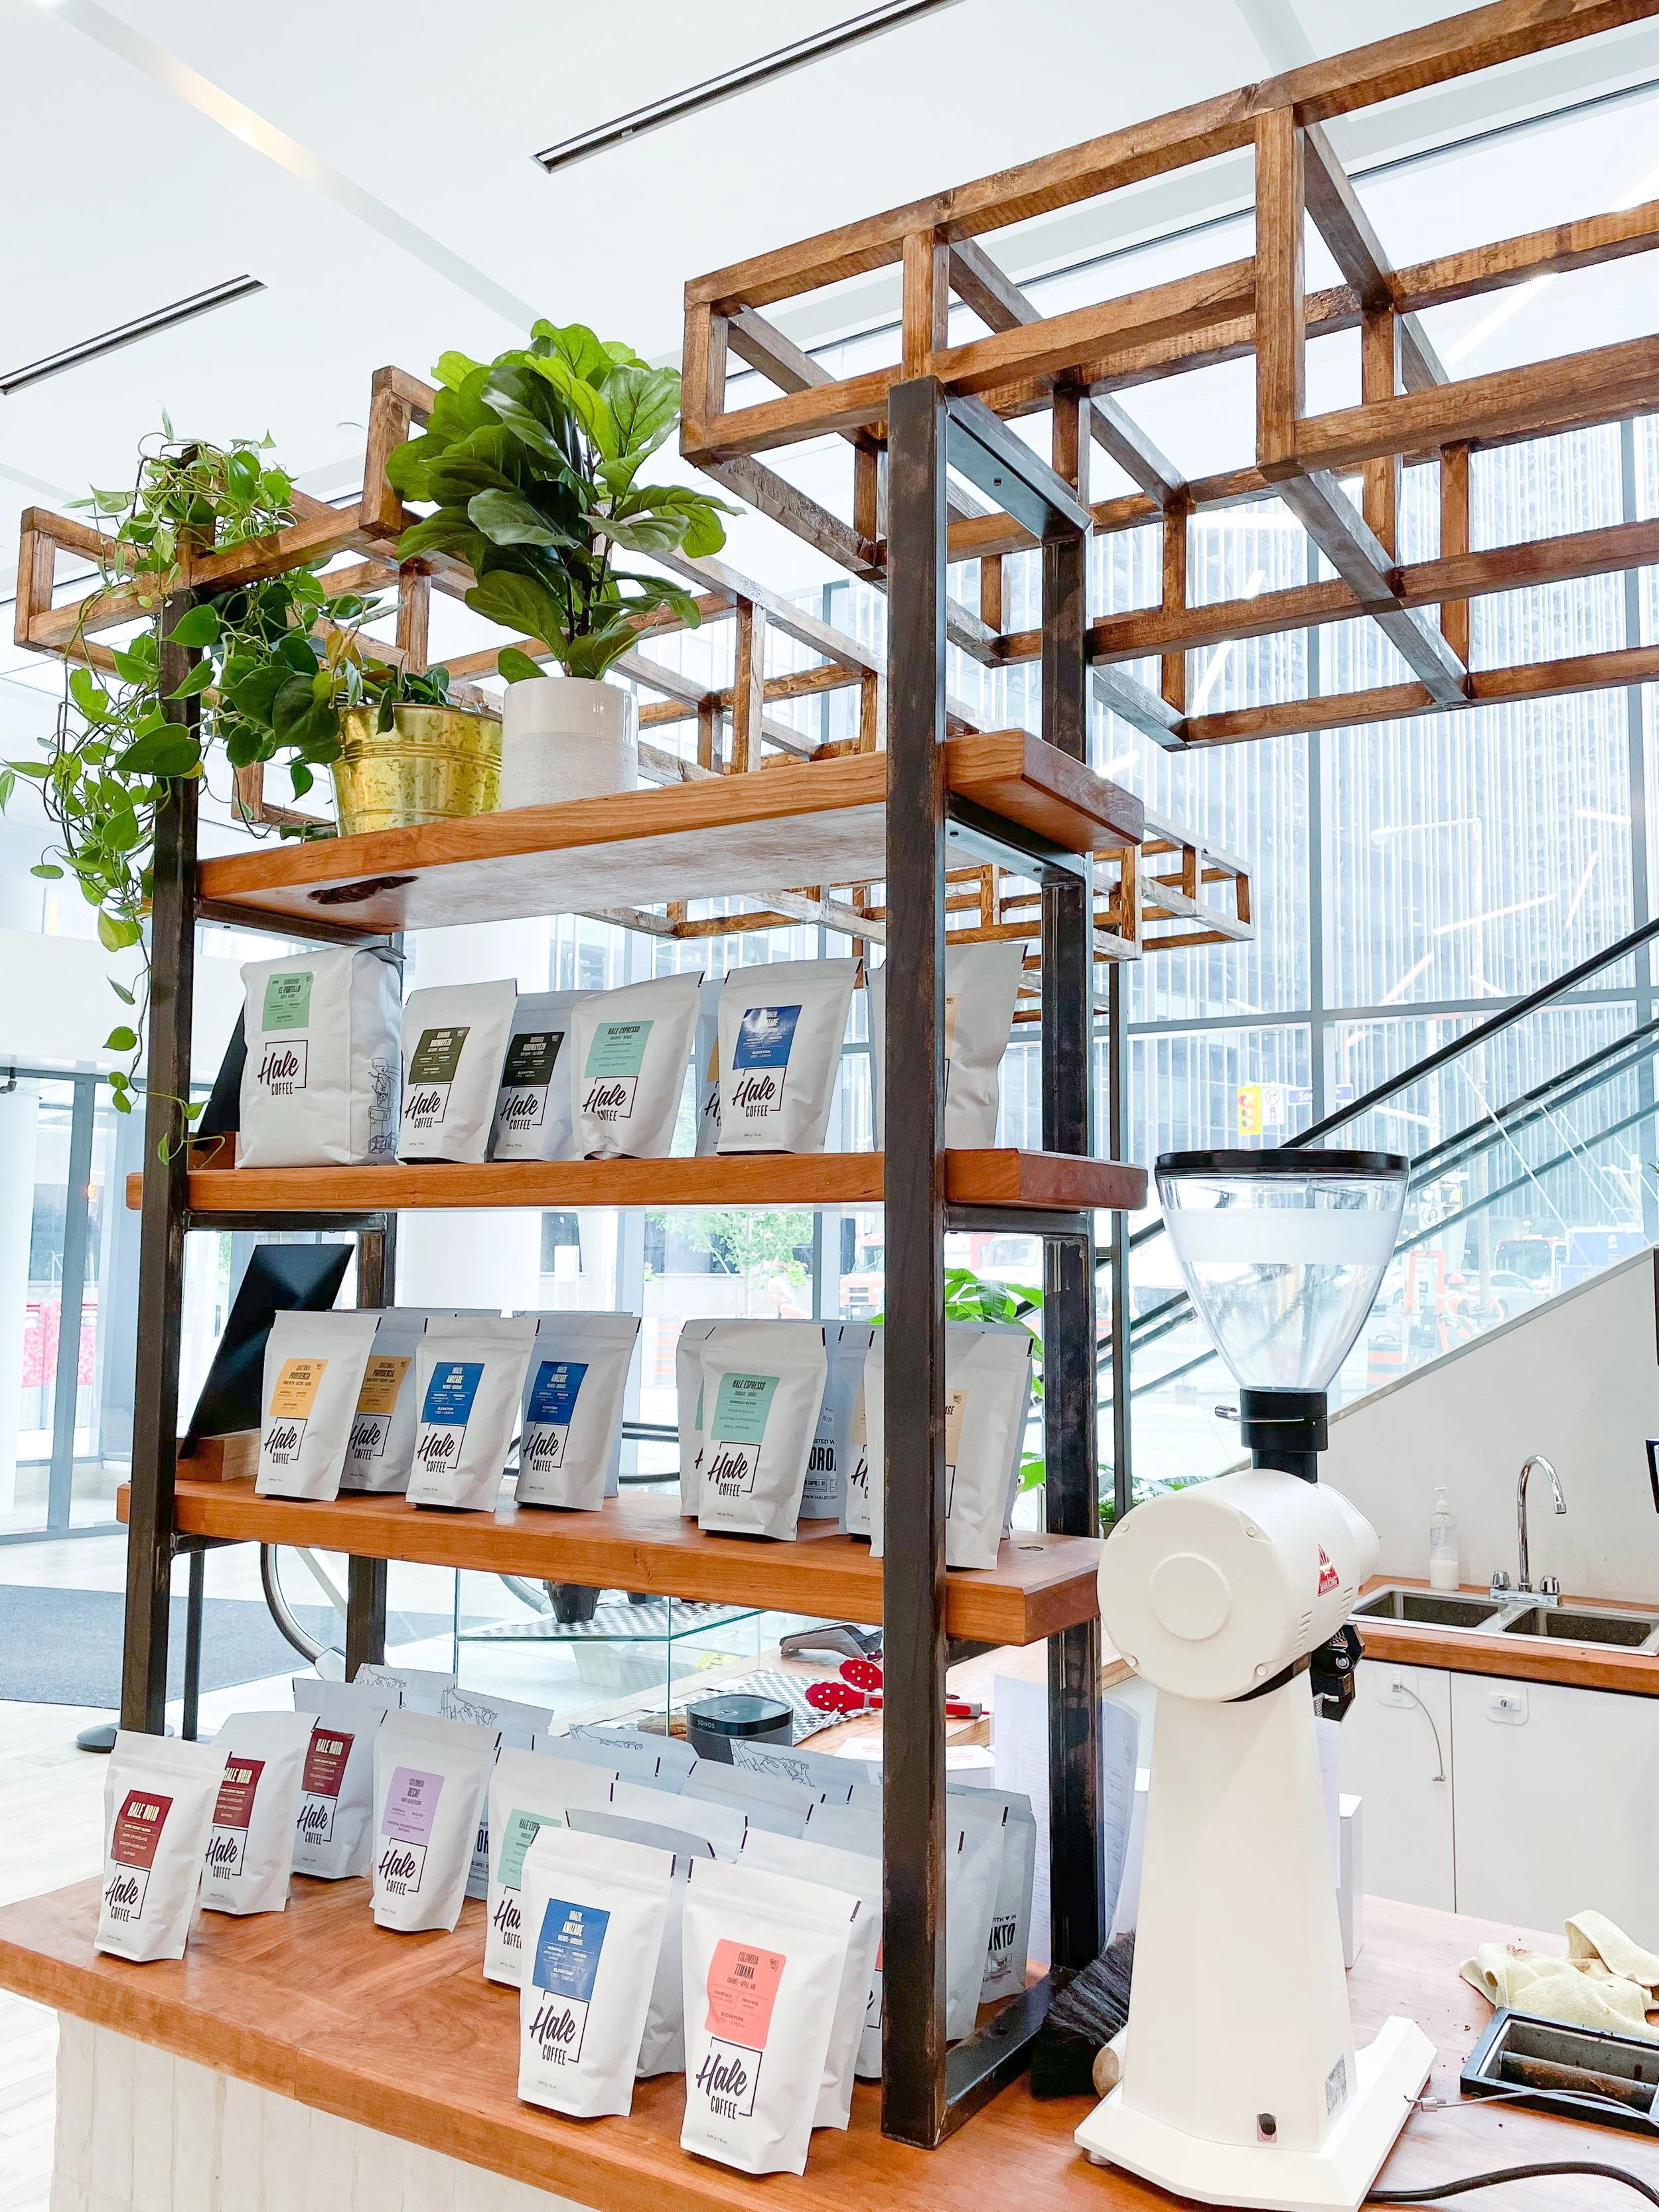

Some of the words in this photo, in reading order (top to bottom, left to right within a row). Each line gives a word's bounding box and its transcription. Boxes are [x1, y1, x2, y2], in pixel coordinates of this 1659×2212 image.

[257, 1050, 299, 1086] Hale
[271, 1082, 293, 1096] COFFEE
[583, 1083, 627, 1113] Hale
[731, 1075, 776, 1108] Hale
[404, 1090, 441, 1120] Hale
[500, 1093, 539, 1122] Hale
[746, 1105, 768, 1117] COFFEE
[413, 1117, 433, 1129] COFFEE
[509, 1119, 531, 1130] COFFEE
[597, 1110, 618, 1122] COFFEE
[732, 1379, 744, 1388] HALE
[743, 1380, 766, 1390] ESPRESSO
[264, 1426, 297, 1454] Hale
[349, 1422, 381, 1450] Hale
[354, 1448, 373, 1460] COFFEE
[417, 1432, 455, 1463] Hale
[523, 1432, 559, 1461] Hale
[272, 1452, 289, 1465] COFFEE
[426, 1460, 447, 1473] COFFEE
[532, 1459, 551, 1472] COFFEE
[707, 1451, 749, 1485] Hale
[808, 1446, 837, 1471] ORO
[719, 1483, 741, 1497] COFFEE
[697, 1719, 715, 1729] SONOS
[315, 1738, 331, 1753] HALE
[328, 1740, 344, 1755] NOIR
[236, 1769, 253, 1784] NOIR
[127, 1801, 146, 1818] HALE
[142, 1804, 160, 1822] NOIR
[297, 1803, 328, 1832] Hale
[305, 1831, 323, 1845] COFFEE
[205, 1836, 238, 1867] Hale
[213, 1865, 231, 1880] COFFEE
[378, 1849, 416, 1880] Hale
[105, 1875, 139, 1907] Hale
[386, 1879, 407, 1895] COFFEE
[110, 1905, 131, 1922] COFFEE
[503, 1931, 522, 1949] COFFE
[734, 1963, 755, 1980] TIMANA
[529, 2004, 576, 2045] Hale
[542, 2044, 567, 2066] COFFEE
[696, 2053, 748, 2097] Hale
[710, 2095, 737, 2120] COFFEE
